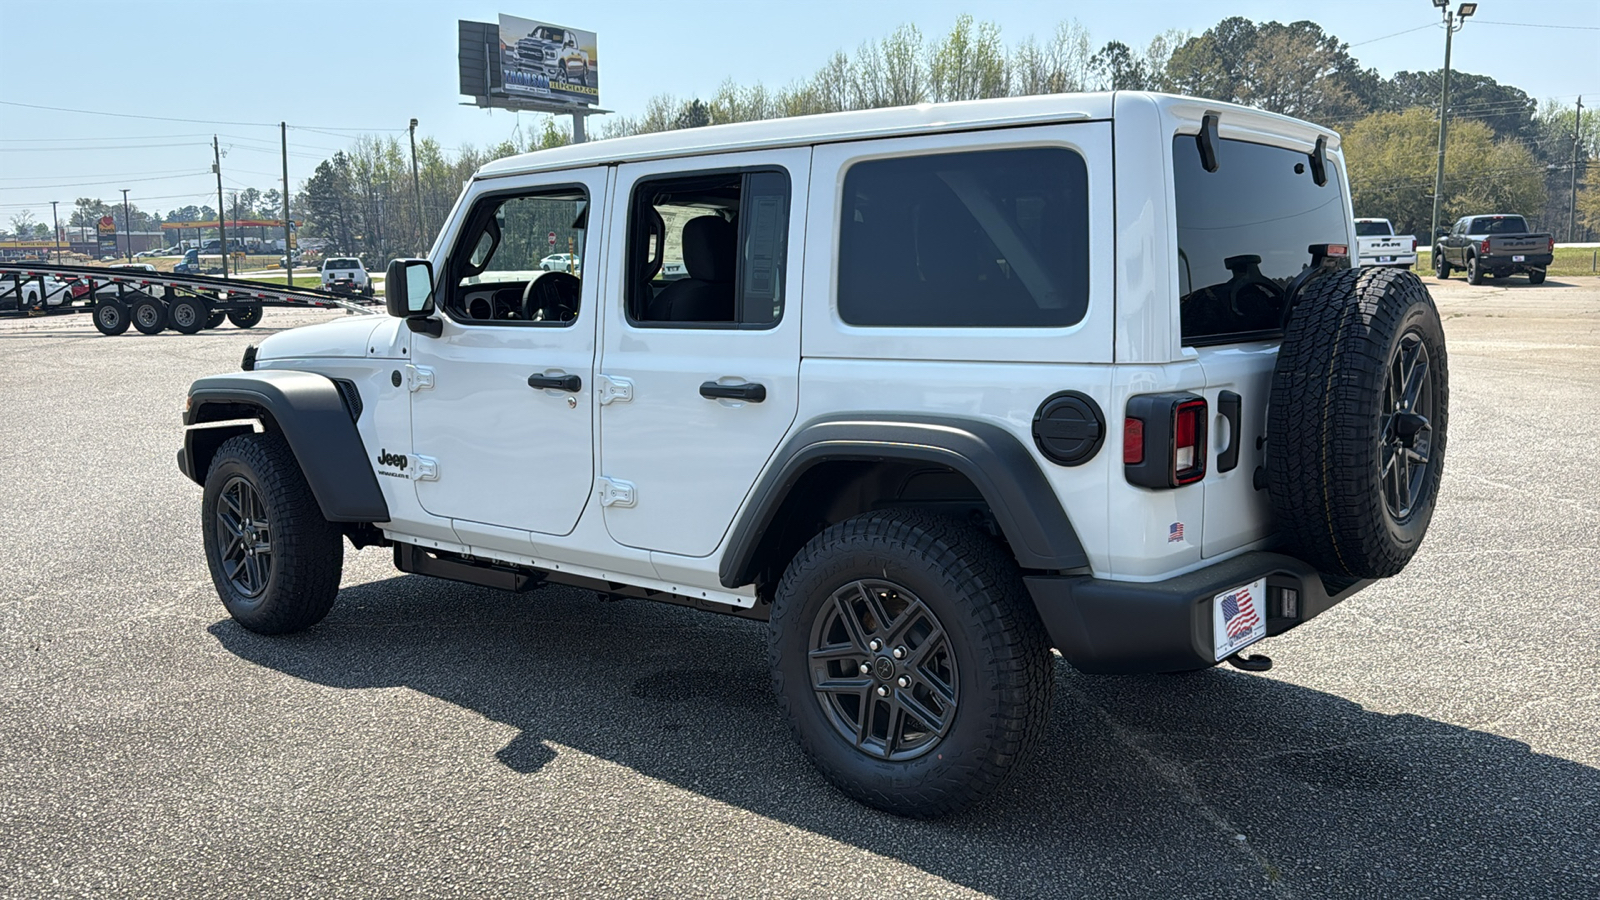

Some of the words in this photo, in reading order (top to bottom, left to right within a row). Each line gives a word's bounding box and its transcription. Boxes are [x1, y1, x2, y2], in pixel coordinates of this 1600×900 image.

[504, 70, 550, 88] THOMSON
[377, 448, 408, 471] Jeep
[377, 470, 405, 479] WRANGLER
